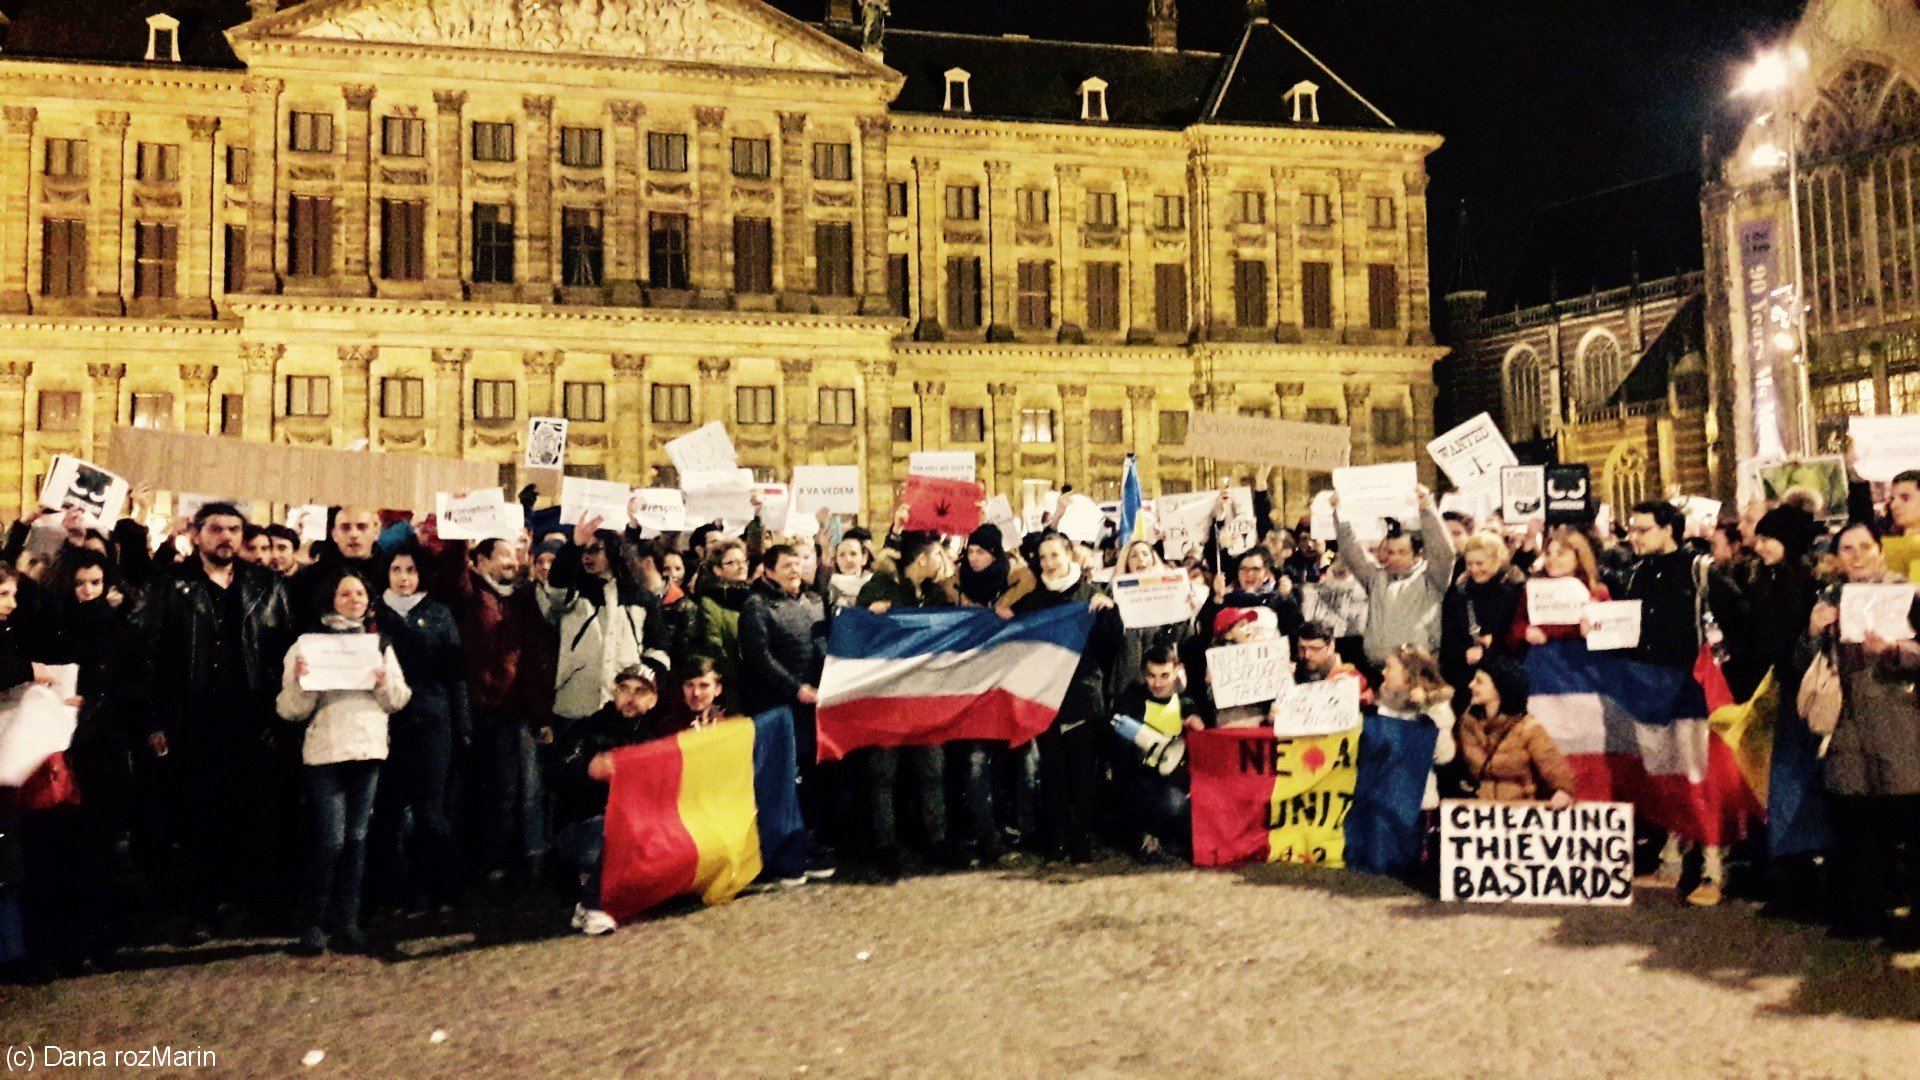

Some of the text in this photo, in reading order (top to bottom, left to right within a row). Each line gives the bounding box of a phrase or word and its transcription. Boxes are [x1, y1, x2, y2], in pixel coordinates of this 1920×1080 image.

[1750, 263, 1768, 295] 90
[1751, 297, 1769, 362] Years
[1437, 426, 1490, 457] WANTED
[822, 487, 855, 495] VEDEM
[1239, 738, 1294, 777] NE
[1450, 805, 1626, 832] CHEATING
[1449, 834, 1630, 863] THIEVING
[1453, 863, 1631, 899] BASTARDS
